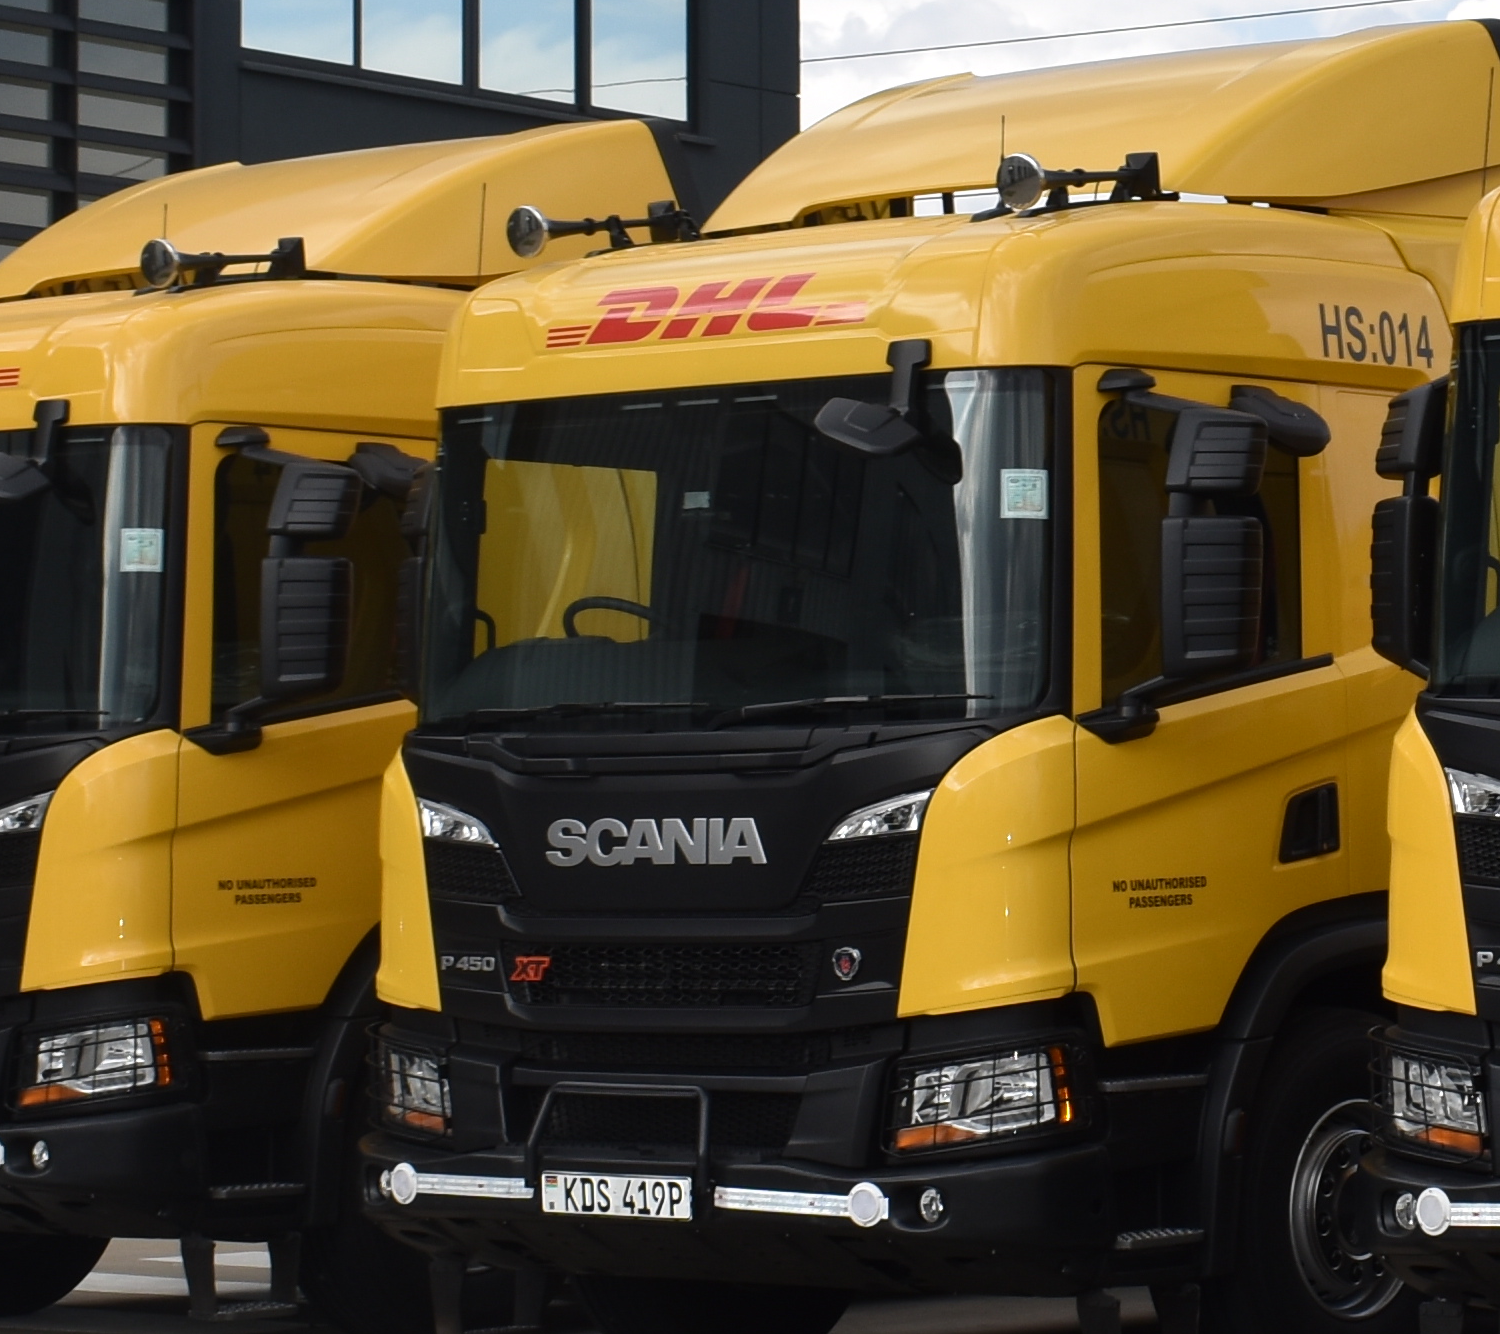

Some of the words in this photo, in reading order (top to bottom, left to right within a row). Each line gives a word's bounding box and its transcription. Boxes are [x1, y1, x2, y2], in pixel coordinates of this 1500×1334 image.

[585, 272, 821, 345] DHL
[1319, 302, 1434, 369] HS:014
[545, 817, 768, 867] SCANIA
[218, 879, 233, 890] NO
[236, 877, 316, 890] UNAUTHORISED
[1112, 880, 1128, 892] NO
[1130, 876, 1207, 891] UNAUTHORISED
[235, 892, 301, 905] PASSENGERS
[1129, 894, 1193, 908] PASSENGERS
[441, 956, 454, 970] P
[455, 956, 495, 971] 450
[1476, 951, 1493, 967] P
[510, 955, 550, 981] XT
[564, 1177, 611, 1213] KDS
[622, 1180, 683, 1217] 419P
